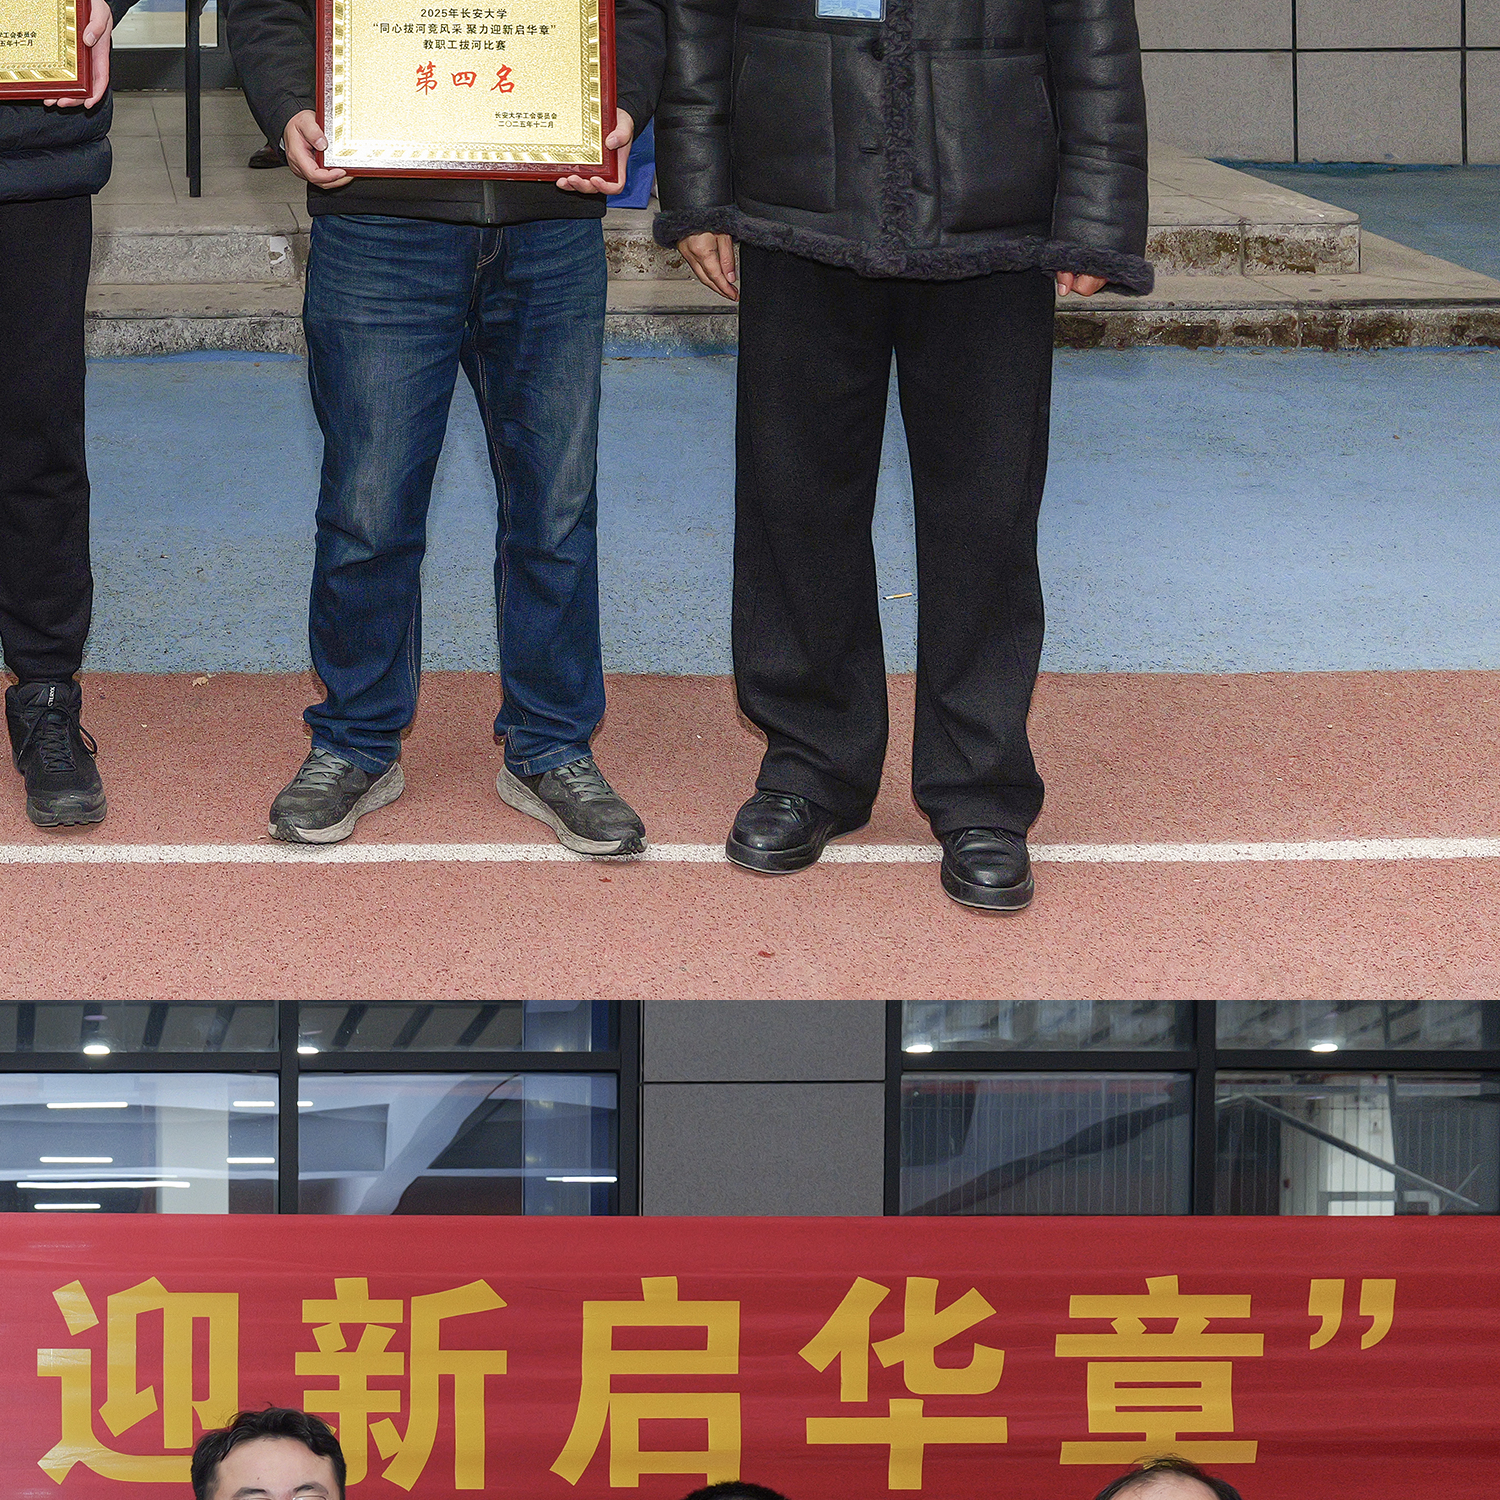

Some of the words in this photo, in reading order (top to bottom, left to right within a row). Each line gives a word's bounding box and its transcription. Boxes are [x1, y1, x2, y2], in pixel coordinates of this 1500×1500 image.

[420, 7, 508, 19] 2025年长安大学
[423, 39, 506, 51] 教职工拔河比赛
[415, 61, 515, 96] 第四名
